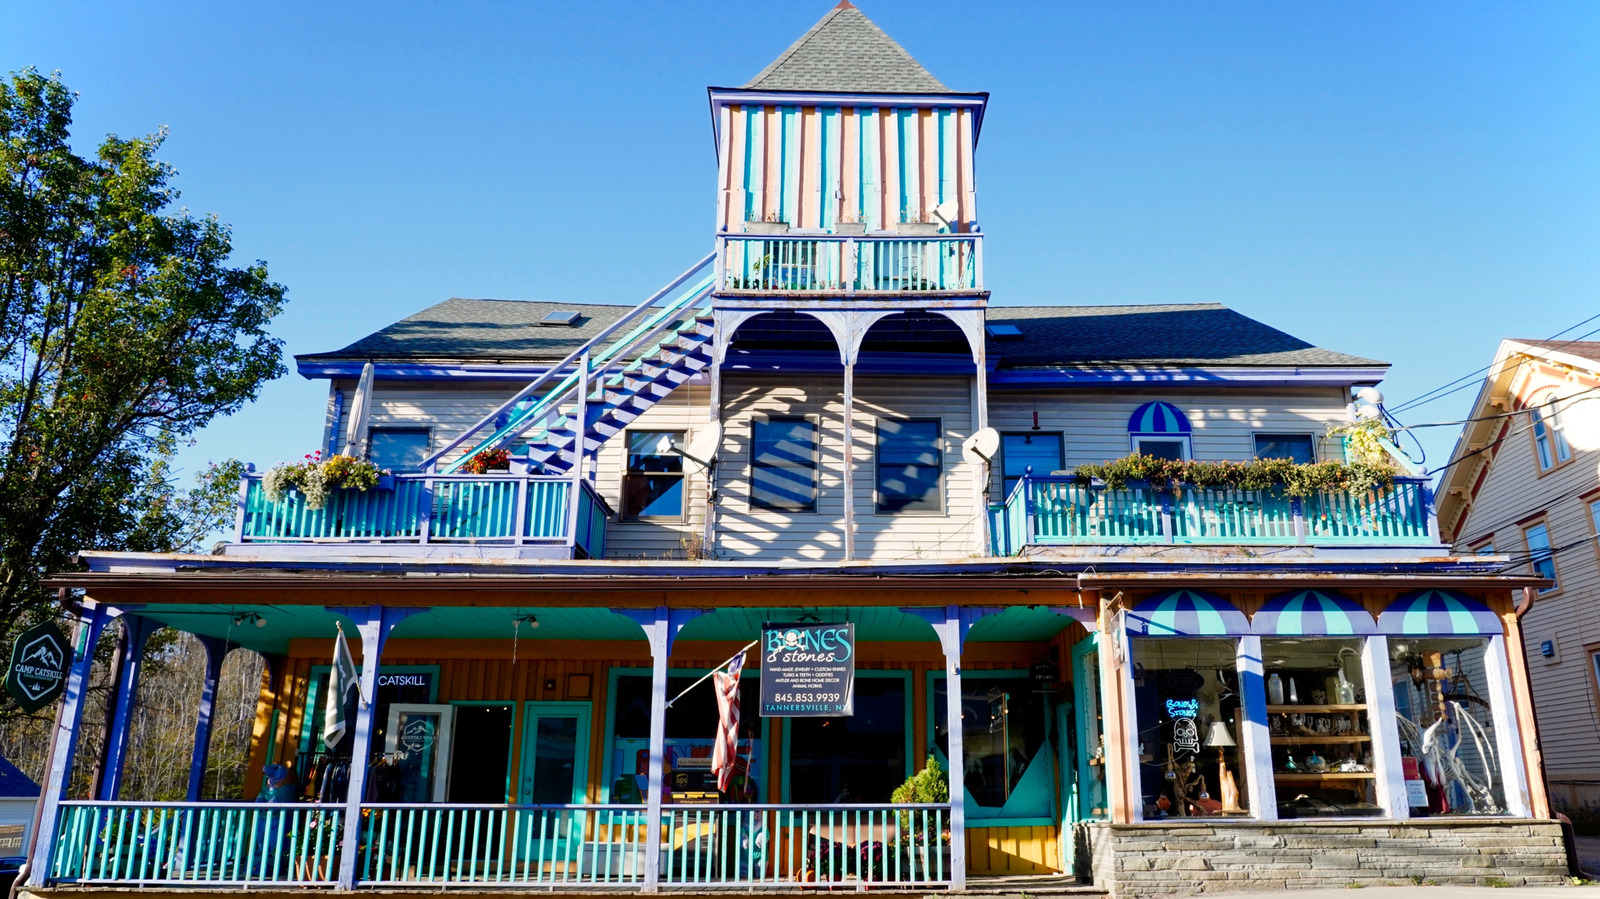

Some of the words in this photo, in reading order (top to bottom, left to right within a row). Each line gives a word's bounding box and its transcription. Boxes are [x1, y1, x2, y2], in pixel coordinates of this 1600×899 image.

[765, 629, 851, 662] BONES
[767, 649, 778, 662] &
[783, 650, 835, 662] stones
[15, 664, 34, 674] CAMP
[35, 668, 62, 679] CATSKILL
[378, 675, 425, 686] CATSKILL
[774, 693, 840, 703] 845.853.9939
[765, 704, 832, 712] TANNERSVILLE,
[677, 778, 688, 786] ups
